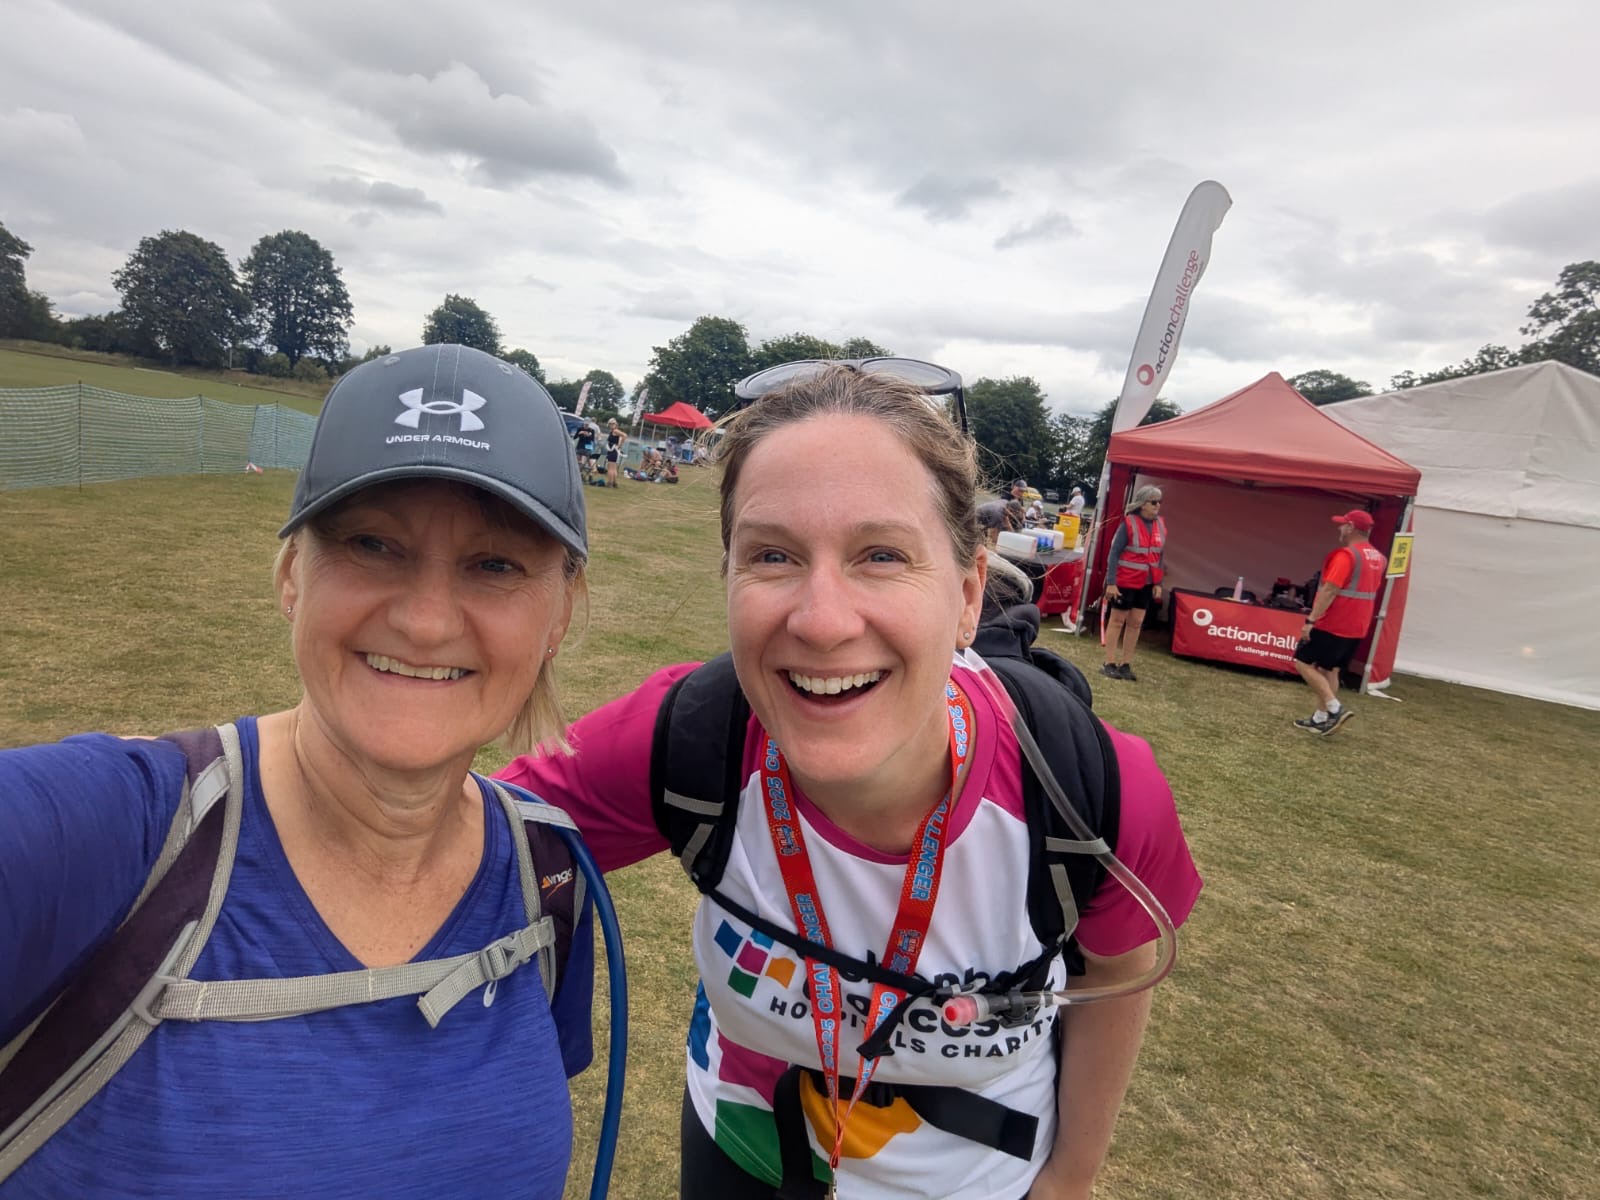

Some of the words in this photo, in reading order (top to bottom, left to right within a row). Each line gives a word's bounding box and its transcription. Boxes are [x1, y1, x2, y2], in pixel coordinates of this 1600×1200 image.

[1156, 249, 1200, 375] actionchallenge
[385, 434, 430, 444] UNDER
[431, 434, 491, 451] ARMOUR
[1207, 624, 1298, 651] actionchall
[1235, 645, 1269, 657] challenge
[1269, 651, 1293, 662] events
[948, 705, 968, 758] 2025
[767, 777, 791, 820] 2025
[910, 793, 950, 902] ALLENGER
[941, 1016, 1053, 1058] CHARIT
